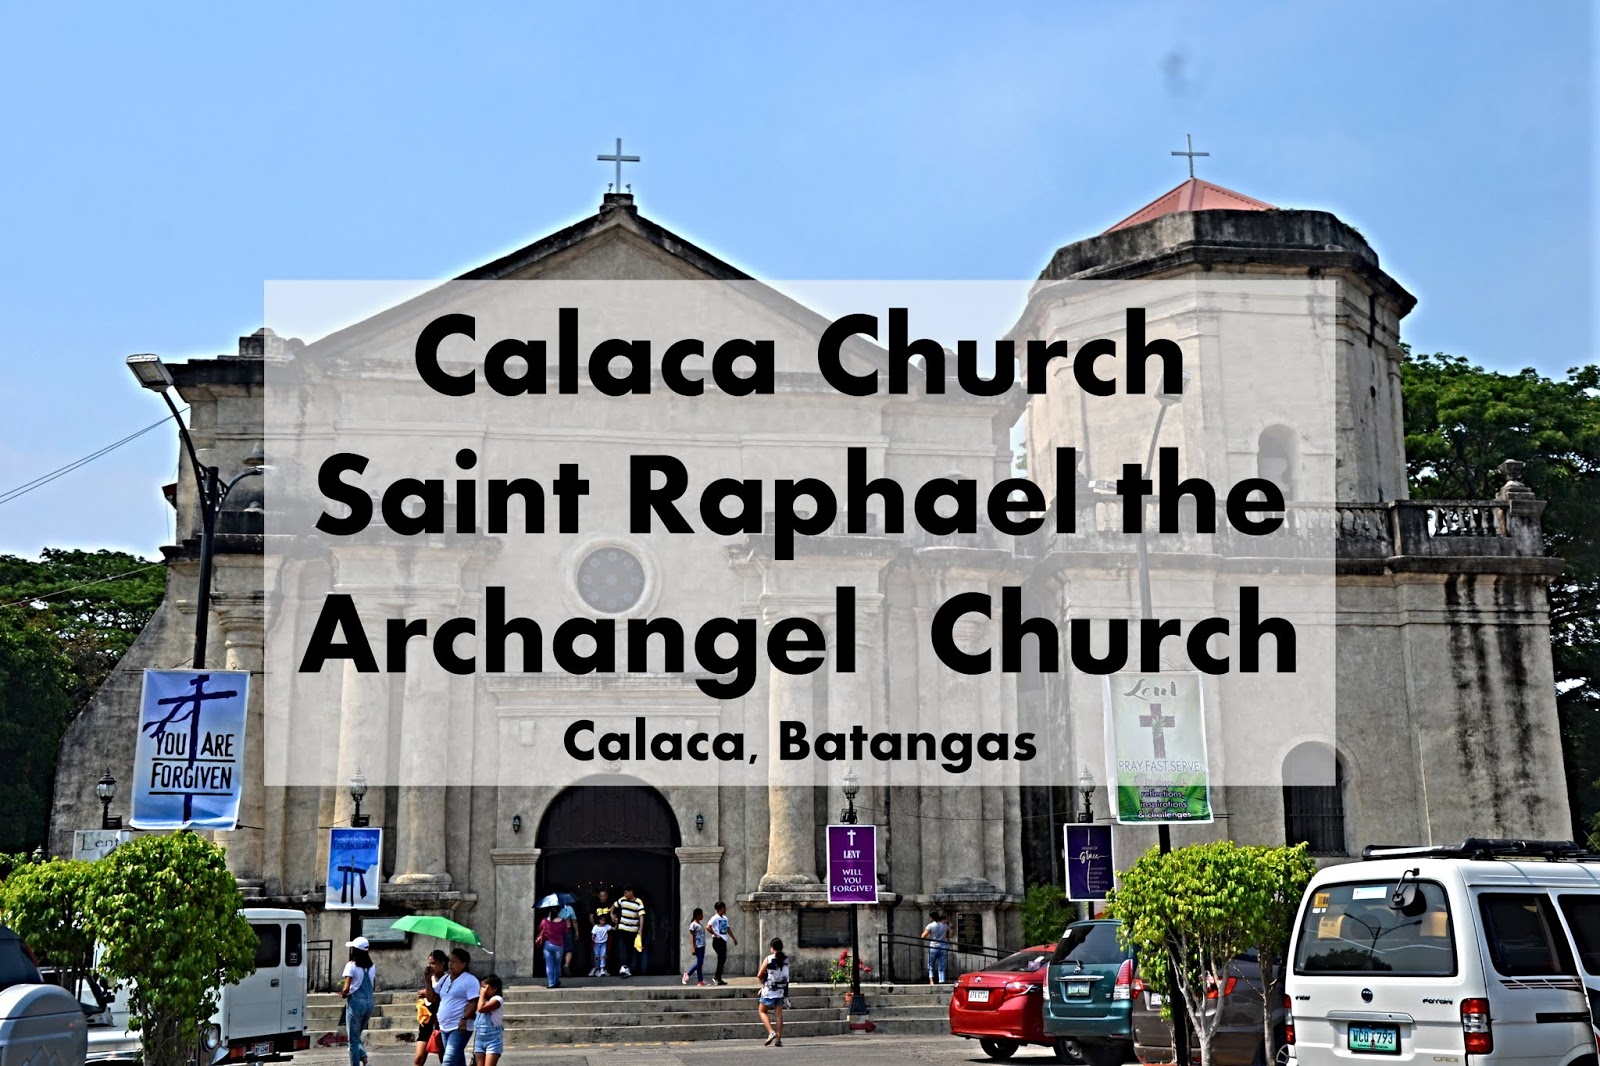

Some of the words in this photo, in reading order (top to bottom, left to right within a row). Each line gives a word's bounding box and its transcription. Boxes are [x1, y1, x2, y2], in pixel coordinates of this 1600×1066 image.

[1123, 678, 1182, 702] Lent
[155, 731, 187, 756] YOU
[200, 731, 235, 757] ARE
[150, 762, 233, 790] FORGIVEN
[1140, 800, 1188, 809] inspirations
[1138, 810, 1145, 819] &
[1147, 810, 1192, 820] challenges
[81, 833, 120, 851] Lent
[843, 850, 861, 859] LENT
[842, 868, 863, 876] WILL
[1376, 1031, 1394, 1045] 793
